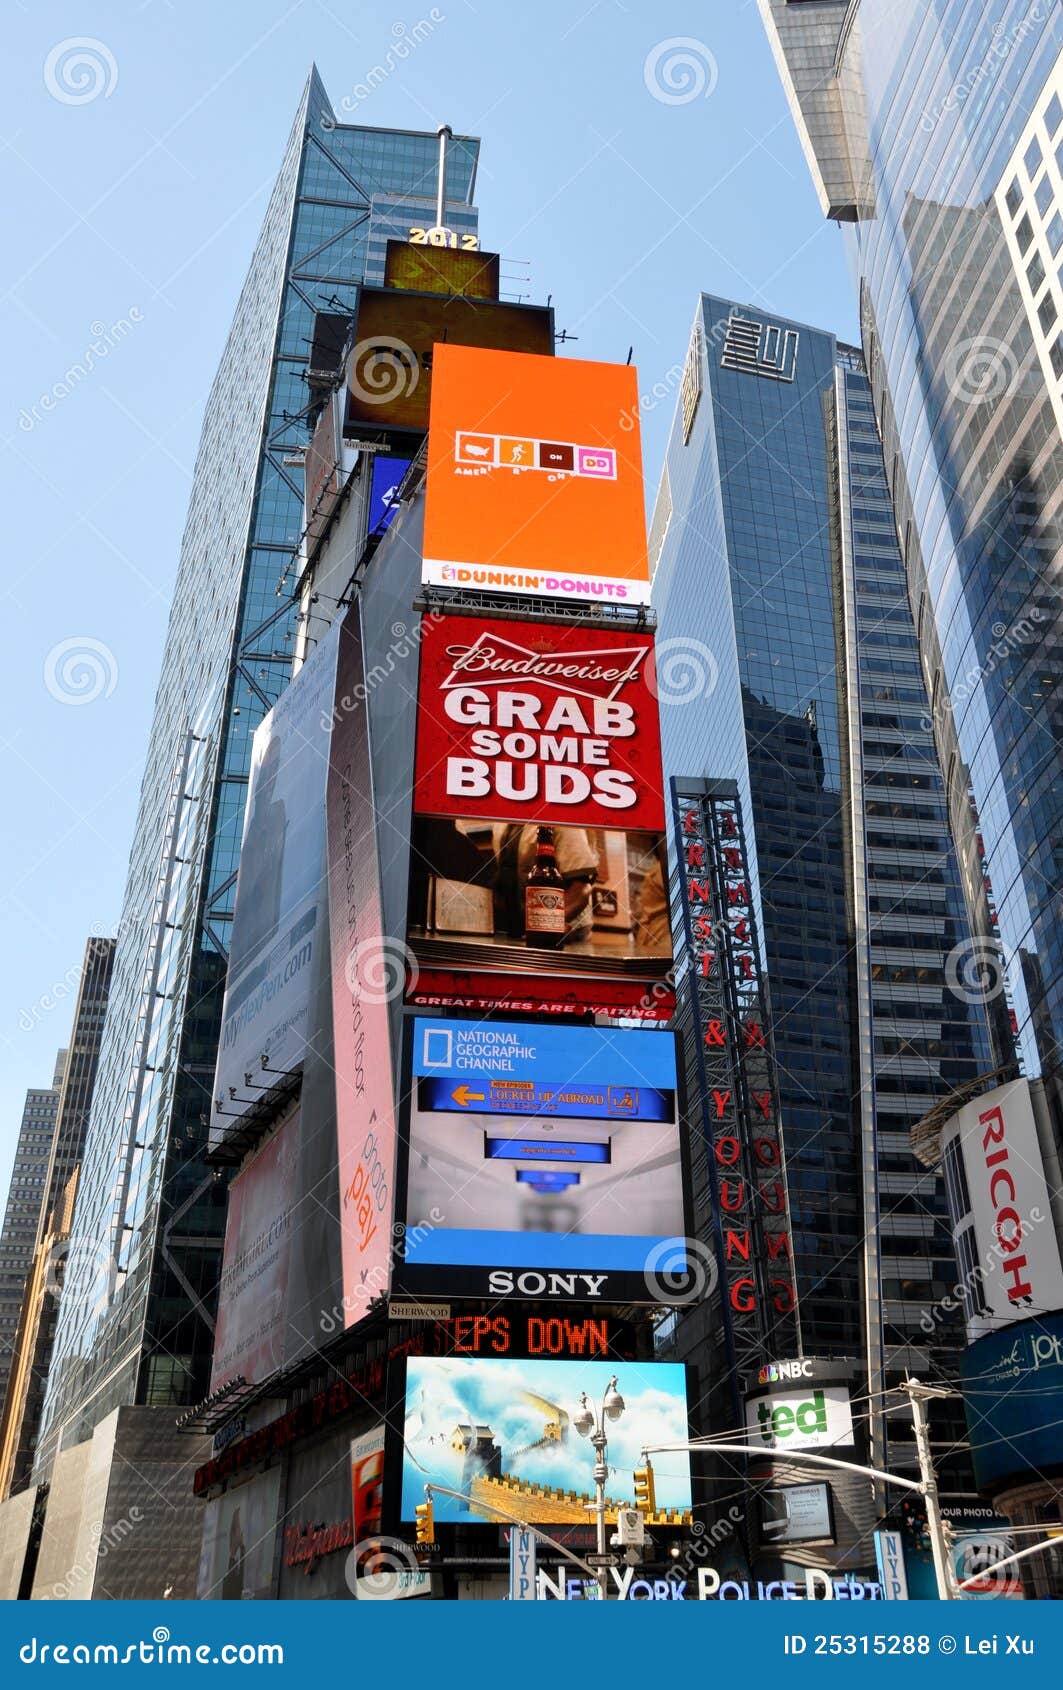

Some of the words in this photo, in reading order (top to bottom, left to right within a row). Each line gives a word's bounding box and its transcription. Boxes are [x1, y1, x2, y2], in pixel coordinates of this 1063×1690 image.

[408, 227, 479, 251] 2012
[549, 453, 563, 461] ON
[454, 465, 496, 476] AMERI
[545, 577, 628, 598] DONUTS
[445, 644, 640, 683] Budweiser
[444, 687, 637, 738] GRAB
[470, 729, 611, 767] SOME
[446, 756, 638, 809] BUDS
[414, 995, 479, 1008] GREAT
[479, 1000, 534, 1011] TIMES
[536, 1003, 577, 1014] ARE
[582, 1005, 658, 1019] WAITING
[456, 1030, 521, 1046] NATIONAL
[456, 1043, 537, 1060] GEOGRAPHIC
[684, 810, 717, 978] ERNST
[712, 1089, 756, 1313] YOUNG
[455, 1056, 516, 1072] CHANNEL
[489, 1088, 535, 1102] LOCKED
[538, 1091, 554, 1102] UP
[558, 1092, 604, 1106] ABROAD
[361, 1131, 389, 1213] photo
[350, 1162, 378, 1253] play
[978, 1105, 1033, 1301] RICOH
[488, 1270, 609, 1297] SONY
[389, 1305, 449, 1318] SHERWOOD
[527, 1317, 609, 1356] DOWN
[778, 1360, 814, 1380] NBC
[757, 1389, 828, 1441] ted
[938, 1507, 962, 1517] YOUR
[963, 1507, 994, 1518] PHOTO
